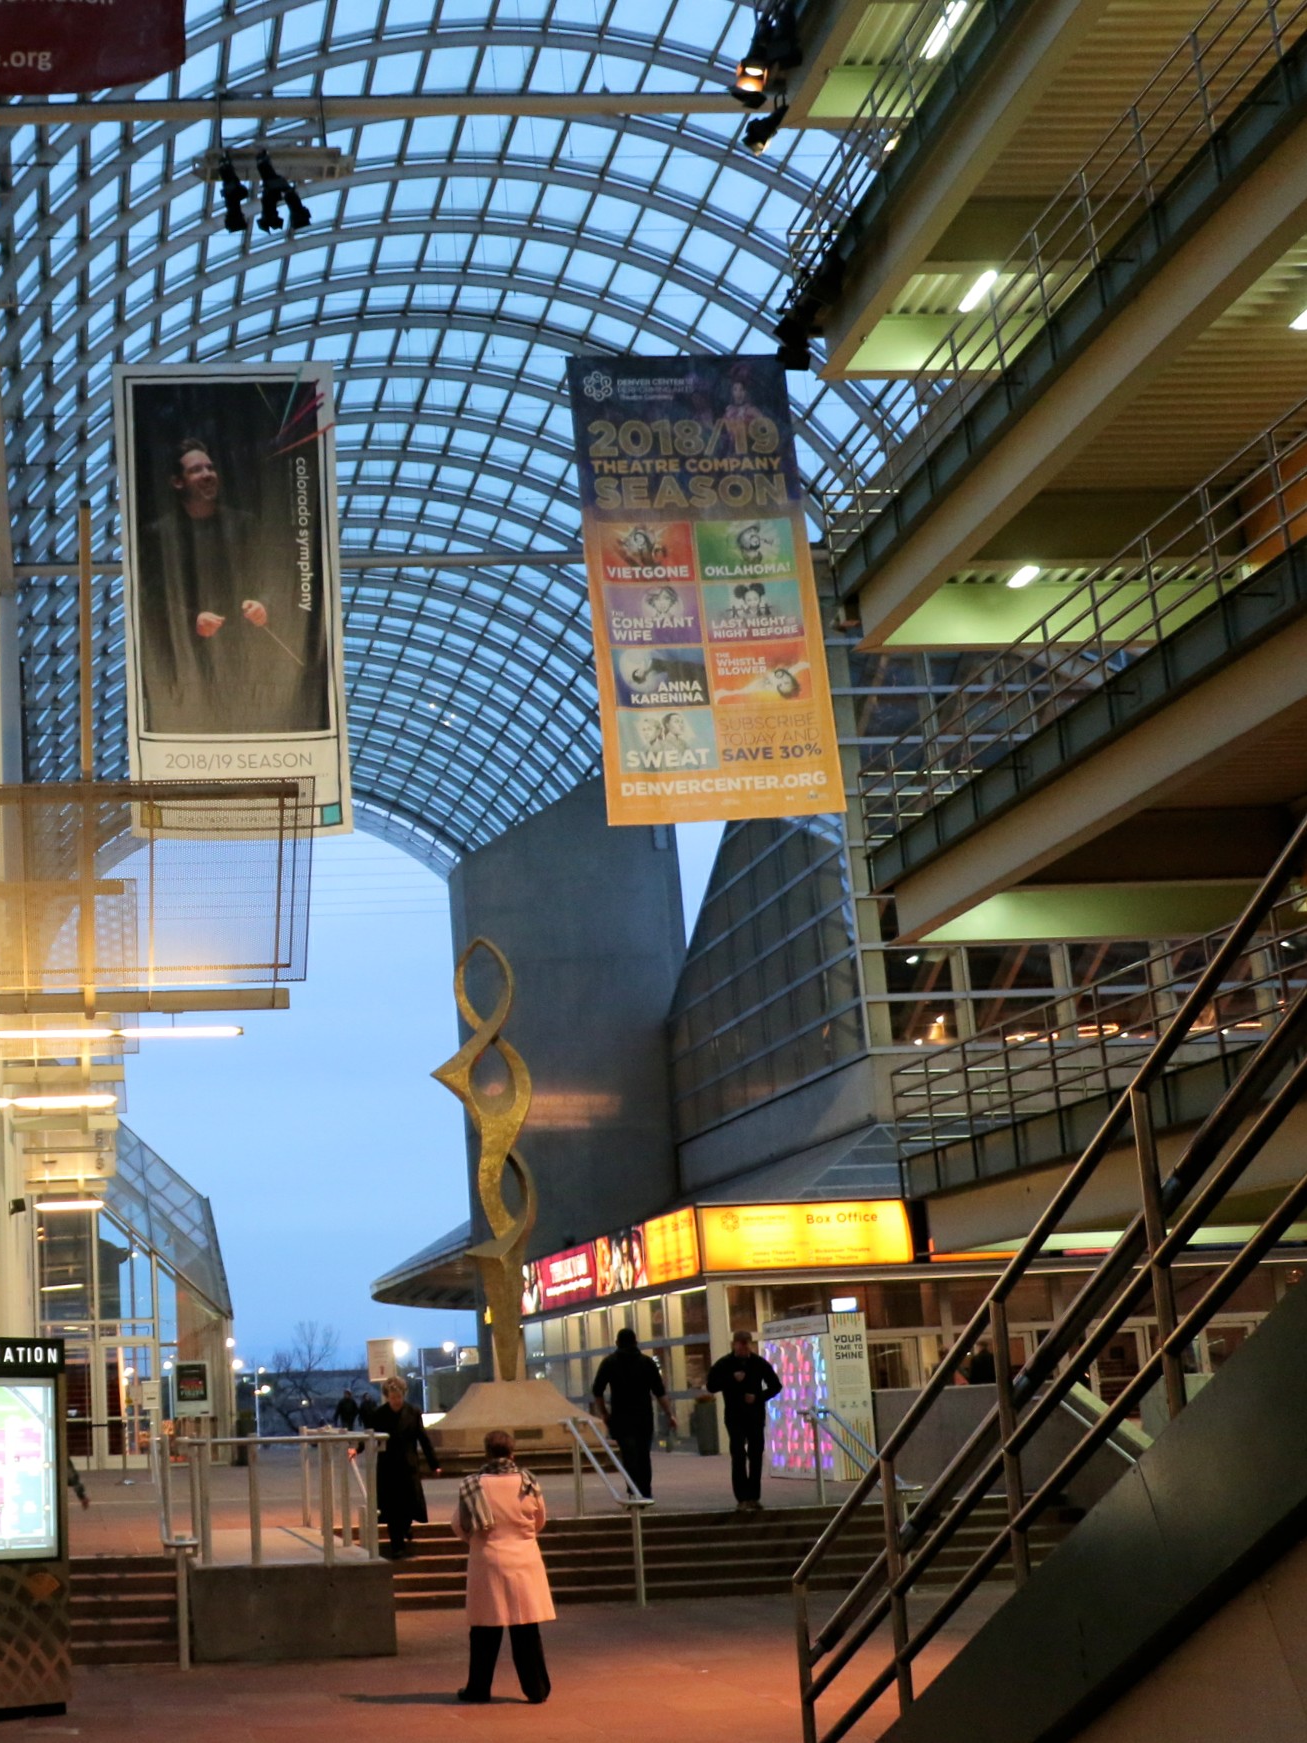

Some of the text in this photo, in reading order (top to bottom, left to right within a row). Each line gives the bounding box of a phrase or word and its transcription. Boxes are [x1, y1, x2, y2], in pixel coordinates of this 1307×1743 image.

[588, 418, 779, 456] 2018/19
[592, 457, 781, 473] THEATRE COMPANY
[595, 474, 787, 508] SEASON
[296, 456, 314, 612] colorado symphony
[606, 565, 690, 579] VIETGONE
[704, 562, 791, 577] OKLAHOMA!
[612, 616, 694, 630] CONSTANT
[711, 619, 743, 630] LAST
[747, 616, 786, 627] NIGHT
[613, 629, 652, 642] WIFE
[713, 625, 799, 639] NIGHT BEFORE
[715, 656, 766, 667] WHISTLE
[717, 666, 767, 676] BLOWER
[657, 680, 703, 693] ANNA
[631, 692, 704, 705] KARENINA
[718, 711, 816, 732] SUBSCRIBE
[720, 727, 821, 746] TODAY AND
[626, 748, 710, 769] SWEAT
[722, 743, 822, 762] SAVE 30%
[164, 752, 313, 771] 2018/19 SEASON
[620, 770, 828, 797] DENVERCENTER.ORG
[806, 1212, 878, 1224] Box Office
[834, 1334, 862, 1342] YOUR
[835, 1351, 863, 1359] SHINE
